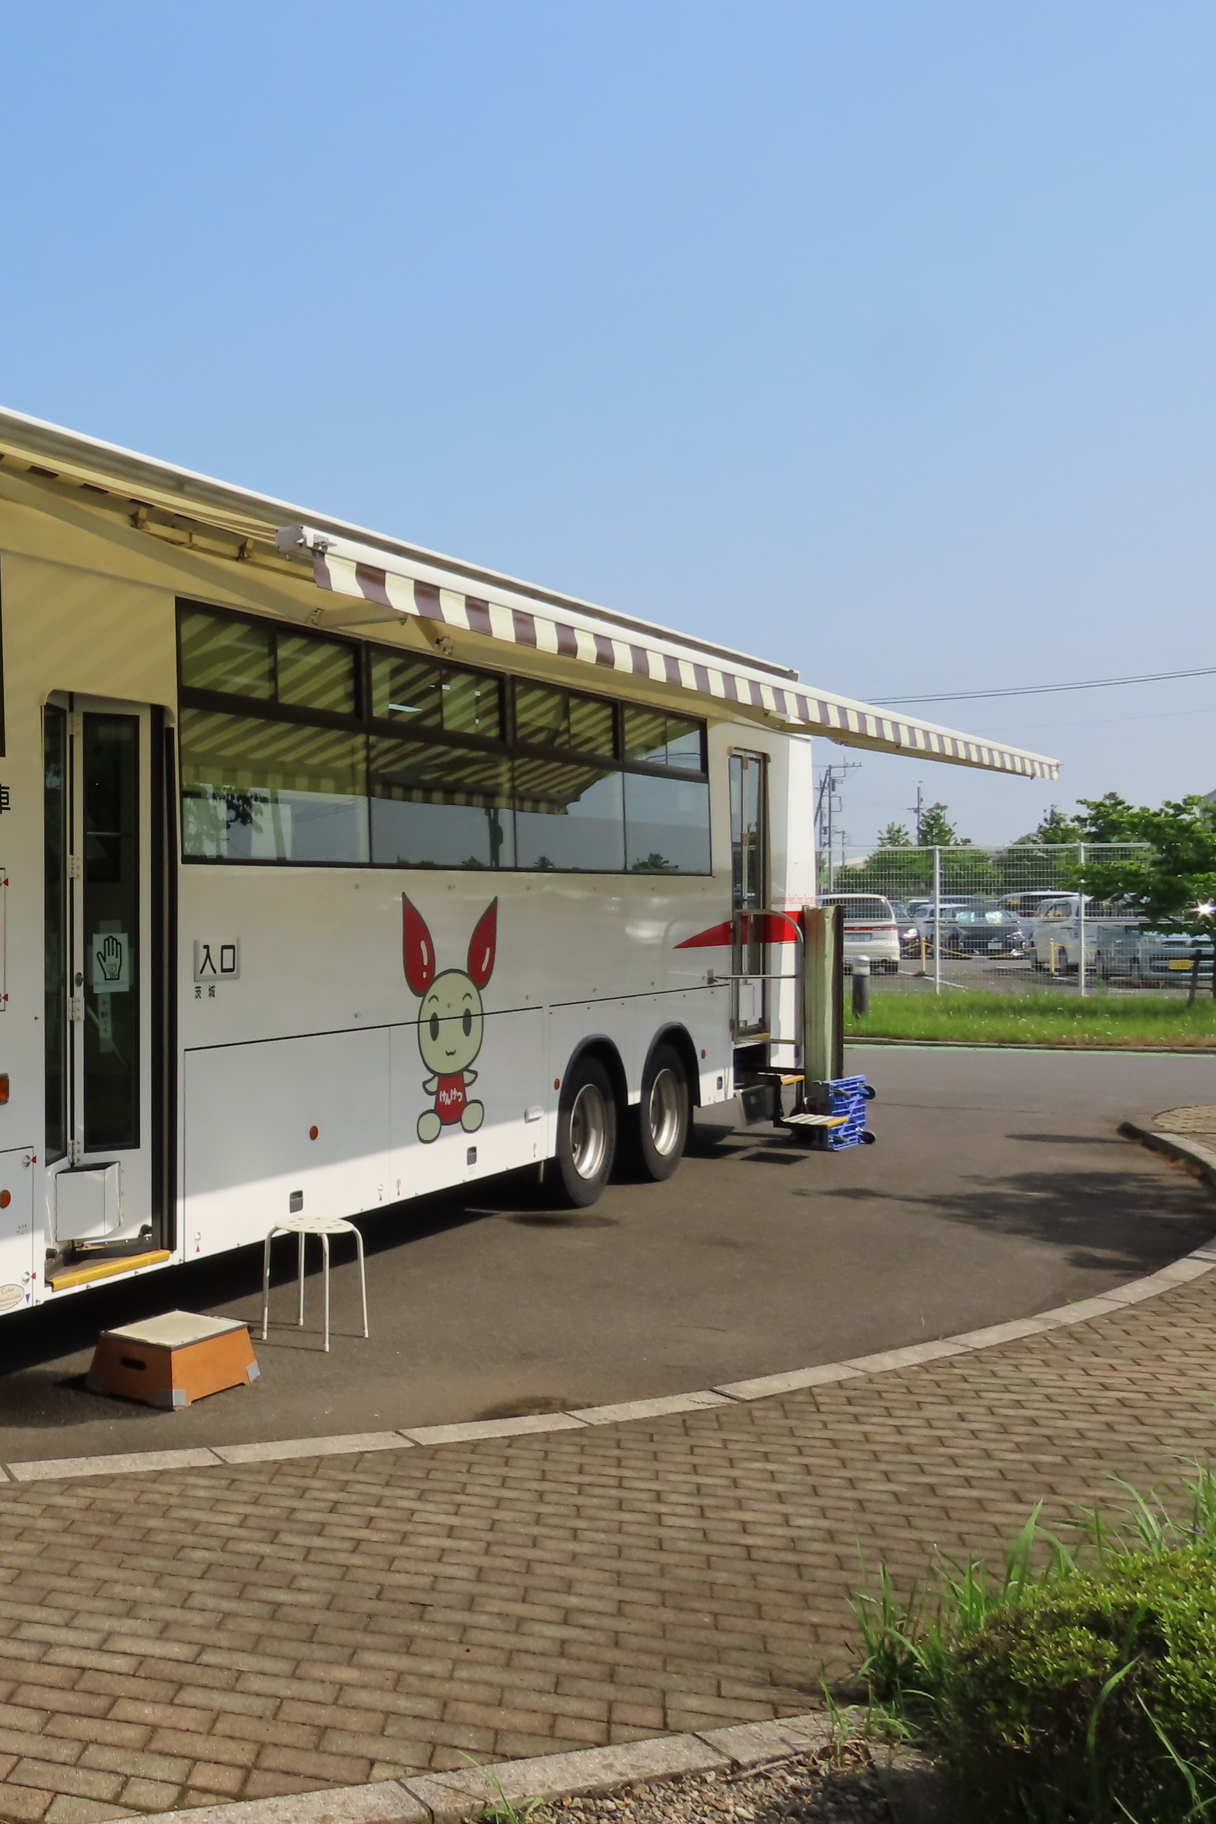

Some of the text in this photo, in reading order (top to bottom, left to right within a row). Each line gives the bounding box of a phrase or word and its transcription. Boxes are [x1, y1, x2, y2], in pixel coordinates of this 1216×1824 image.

[199, 944, 236, 975] 入口
[439, 1087, 463, 1106] けんけつ
